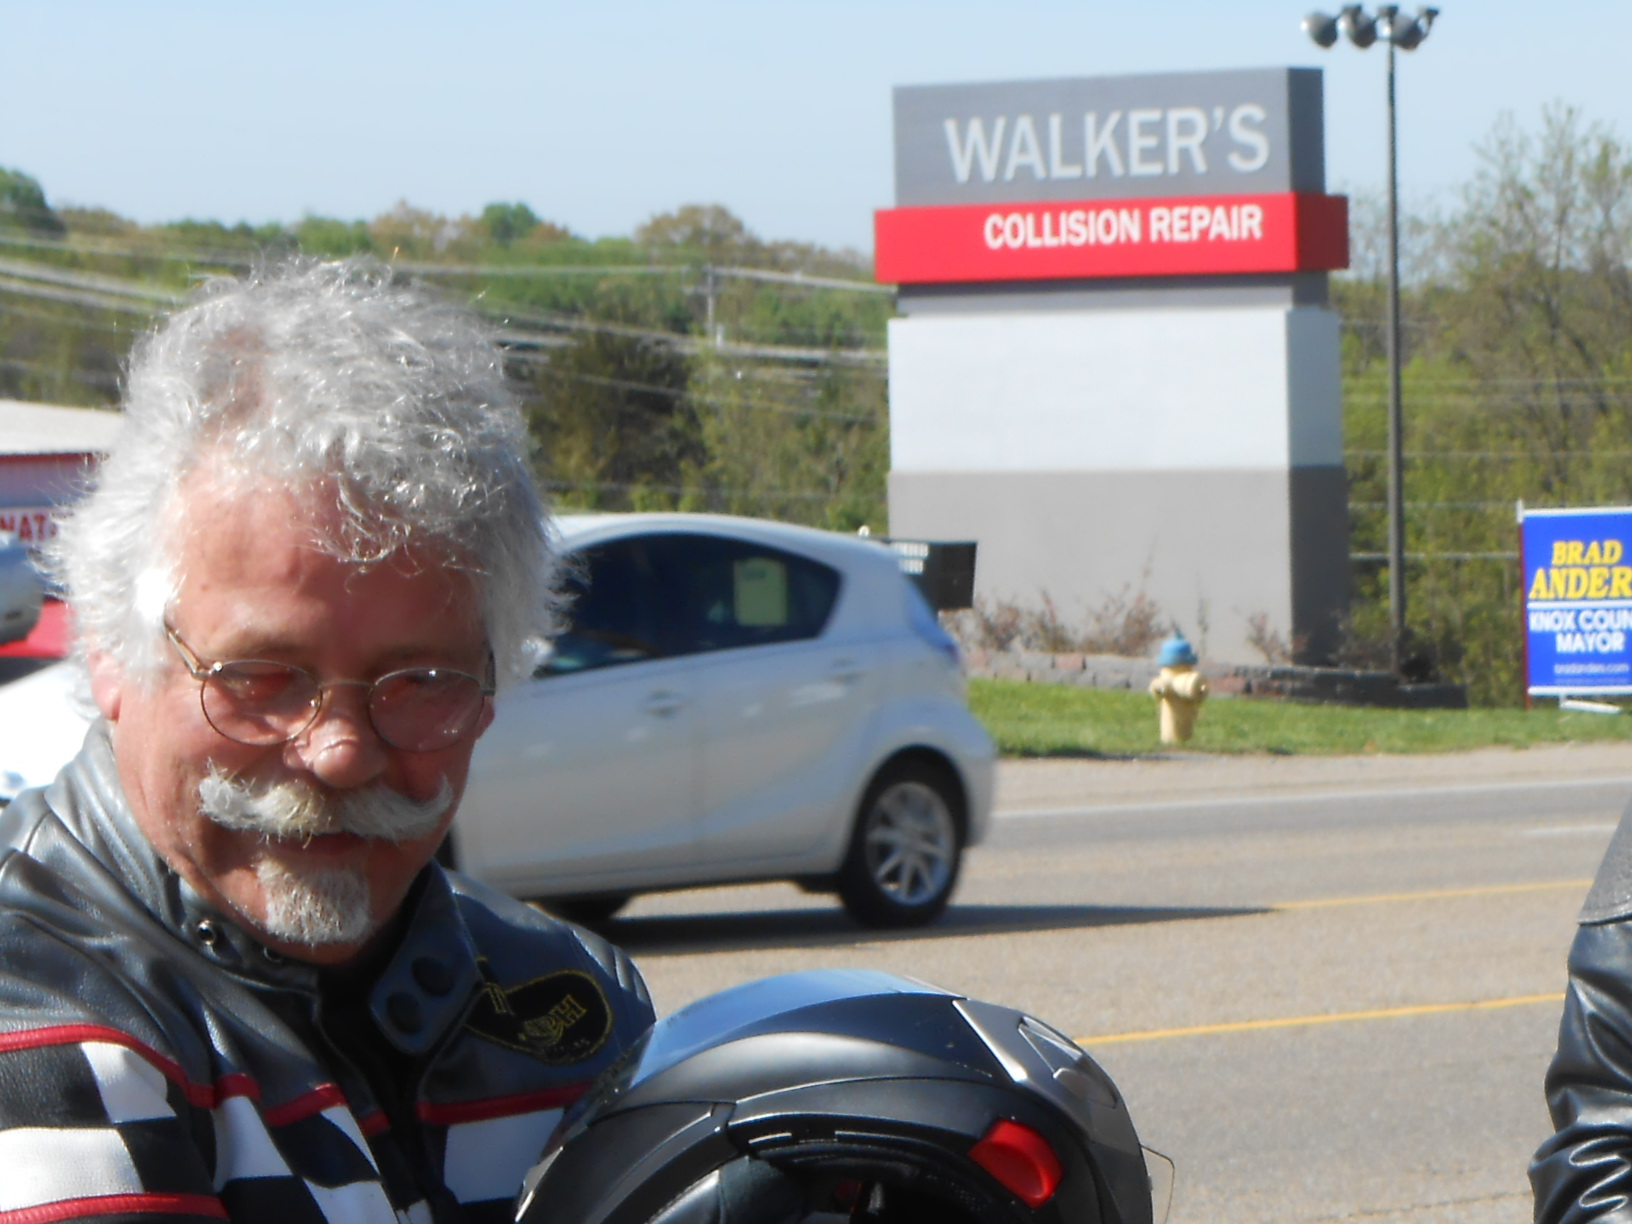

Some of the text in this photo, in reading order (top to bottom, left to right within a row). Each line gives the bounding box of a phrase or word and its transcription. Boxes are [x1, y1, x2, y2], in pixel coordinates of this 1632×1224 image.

[944, 104, 1271, 184] WALKER'S
[983, 204, 1263, 250] COLLISION REPAIR
[1551, 539, 1624, 565] BRAD
[1529, 609, 1577, 631] KNOX
[1555, 631, 1626, 653] MAYOR
